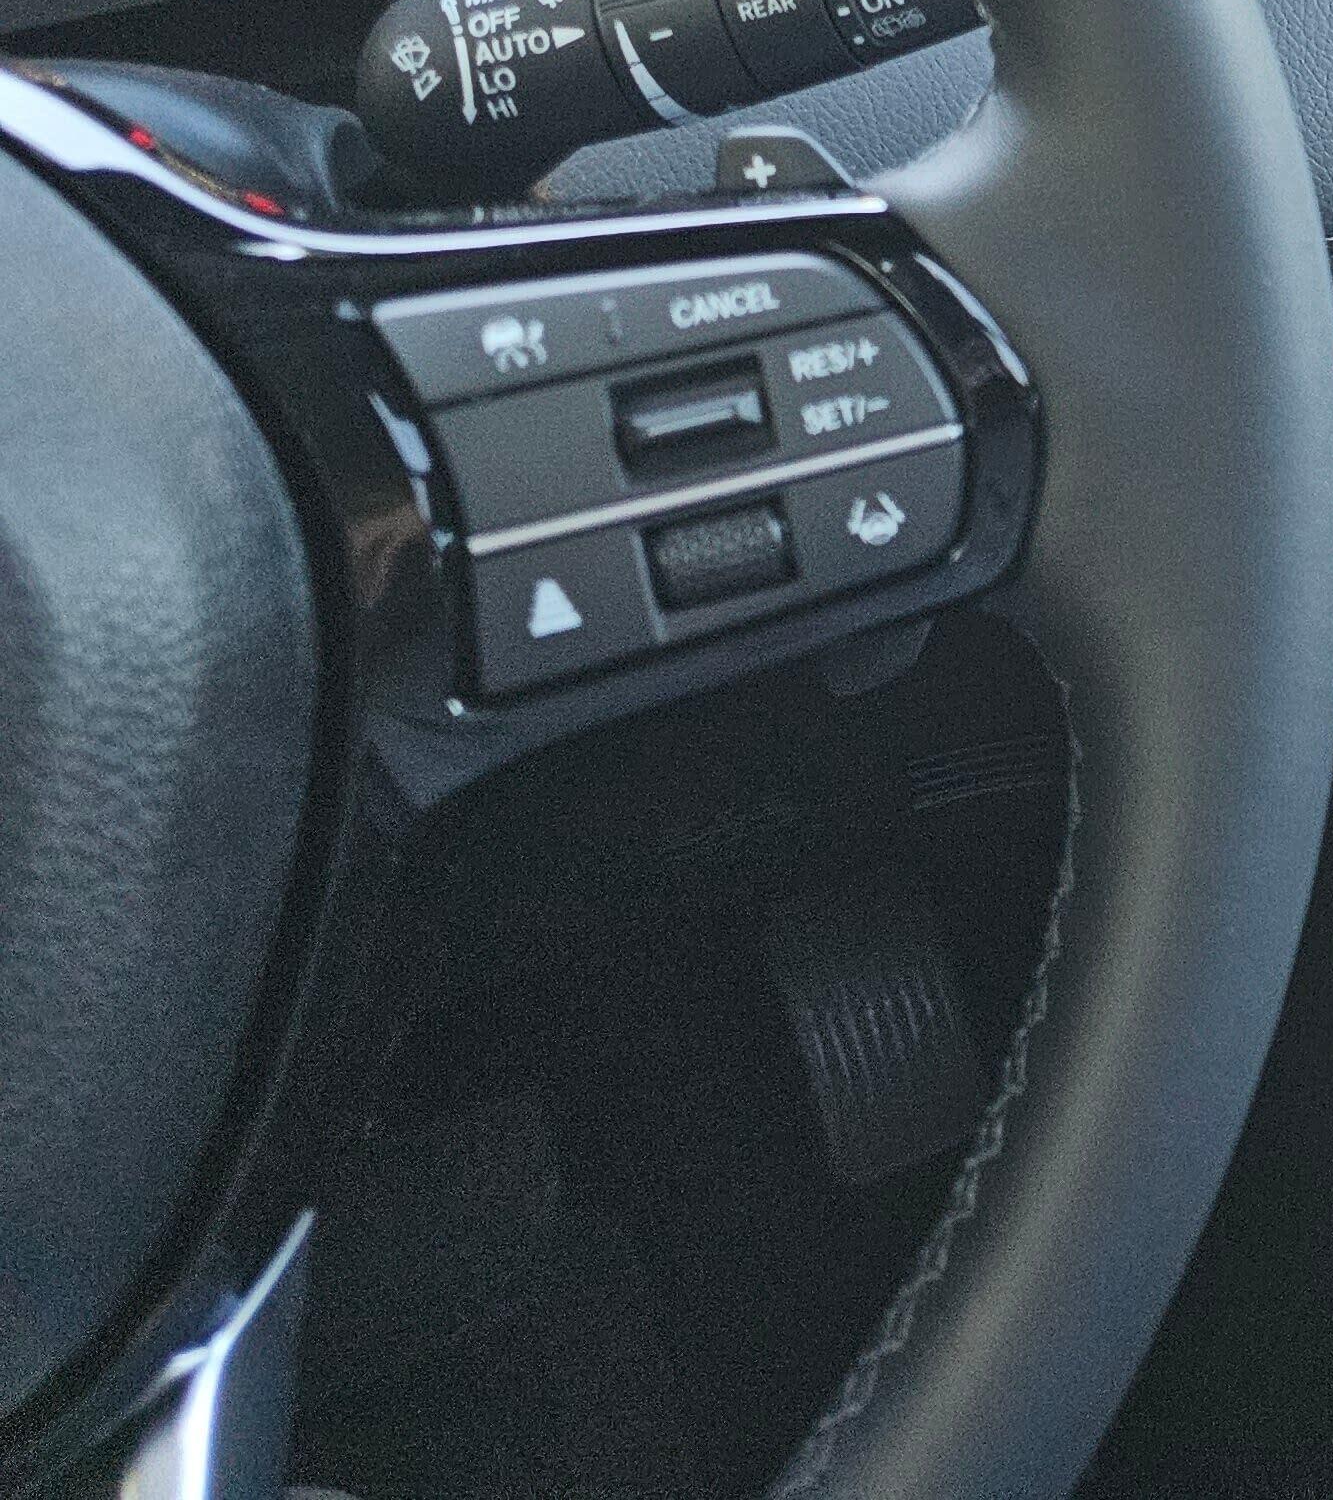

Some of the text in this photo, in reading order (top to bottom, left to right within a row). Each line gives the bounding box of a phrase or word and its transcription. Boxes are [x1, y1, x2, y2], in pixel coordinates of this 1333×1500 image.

[467, 4, 520, 38] OFF
[476, 27, 550, 66] AUTO
[478, 67, 516, 95] LO
[486, 96, 519, 120] HI
[669, 282, 780, 329] CANCEL
